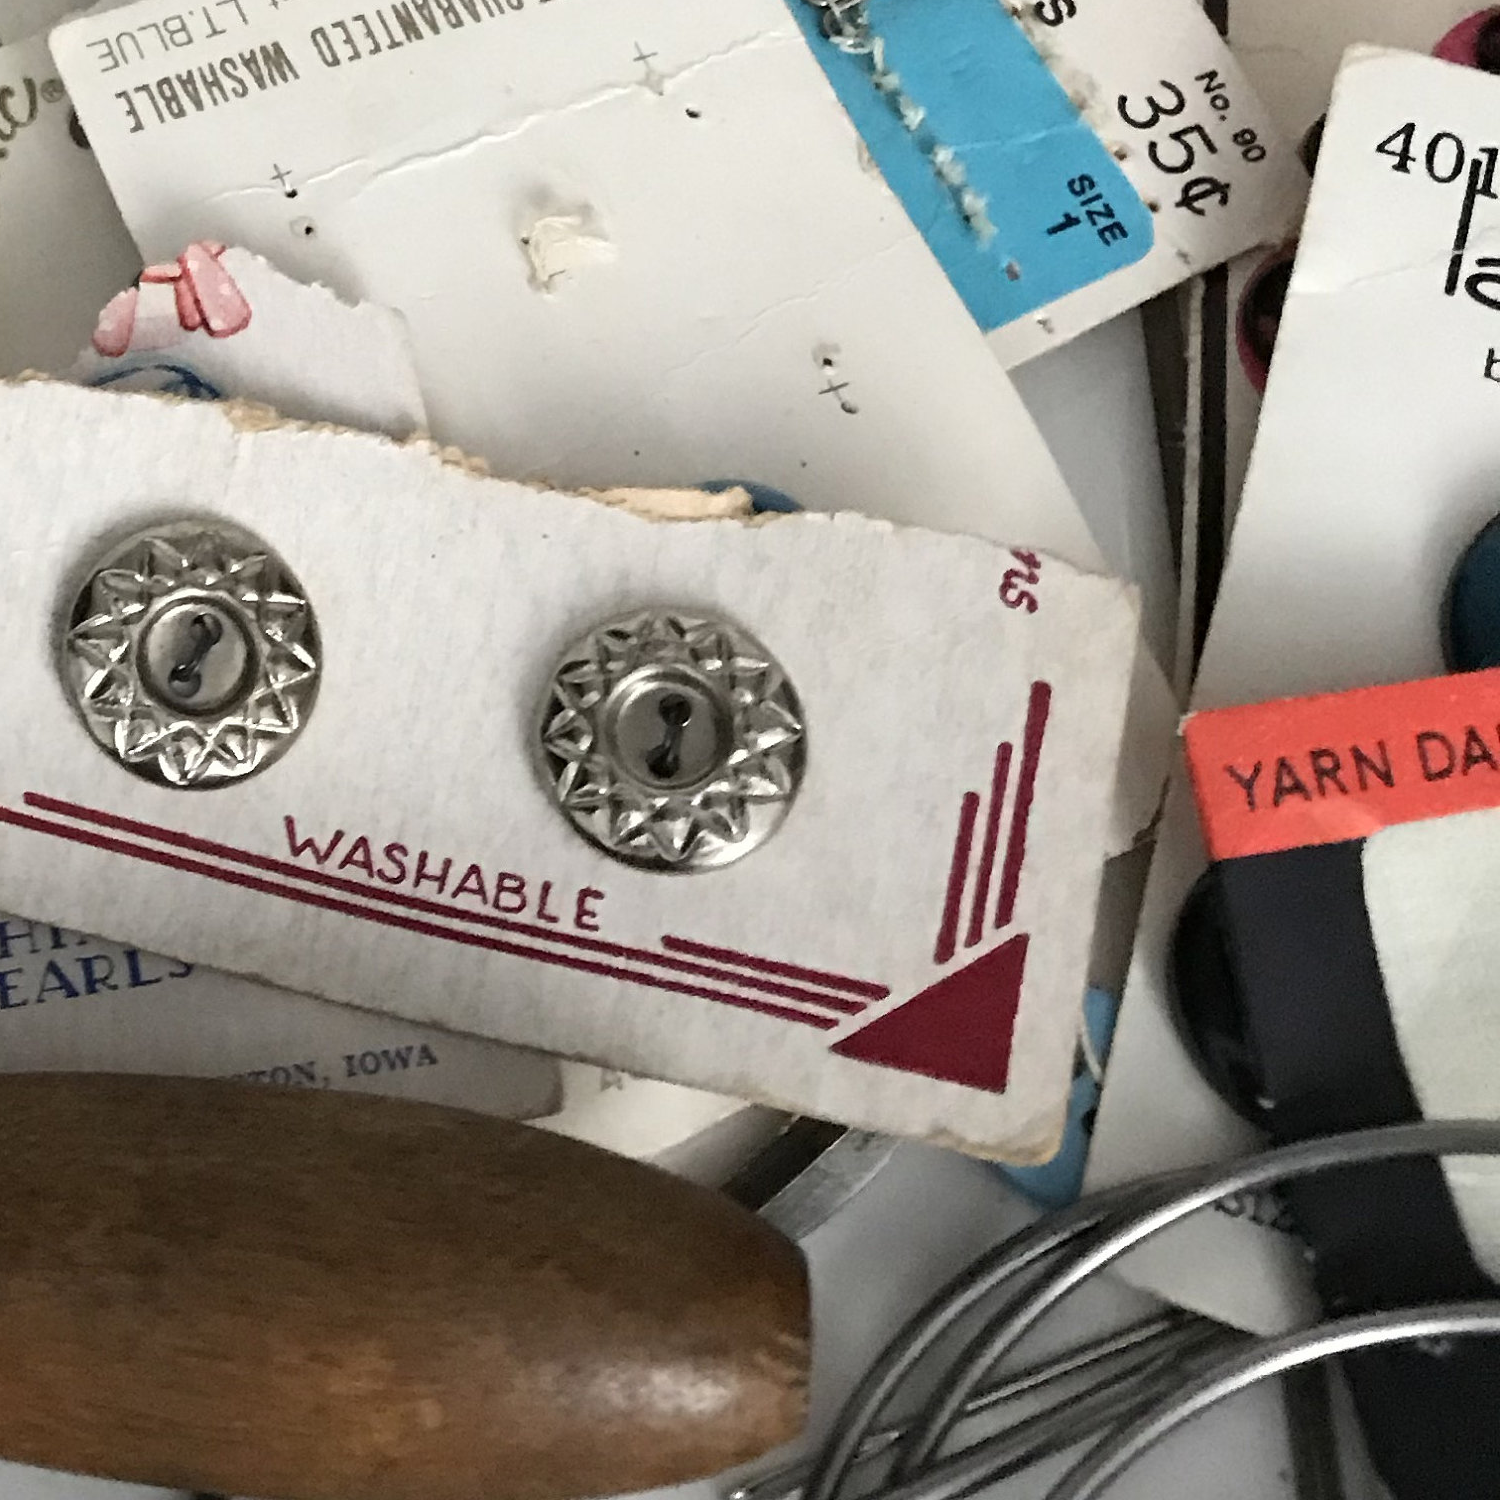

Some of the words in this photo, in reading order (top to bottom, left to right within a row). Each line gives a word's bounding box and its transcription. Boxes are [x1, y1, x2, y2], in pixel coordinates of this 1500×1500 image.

[114, 38, 301, 134] WASHABLE
[1194, 68, 1231, 123] No.
[1116, 79, 1232, 218] 35¢
[1046, 211, 1083, 236] 1
[1066, 172, 1130, 248] SIZE
[1223, 738, 1396, 813] YARN
[1415, 722, 1500, 782] DA
[282, 813, 606, 933] WASHABLE
[341, 1042, 439, 1078] IOWA
